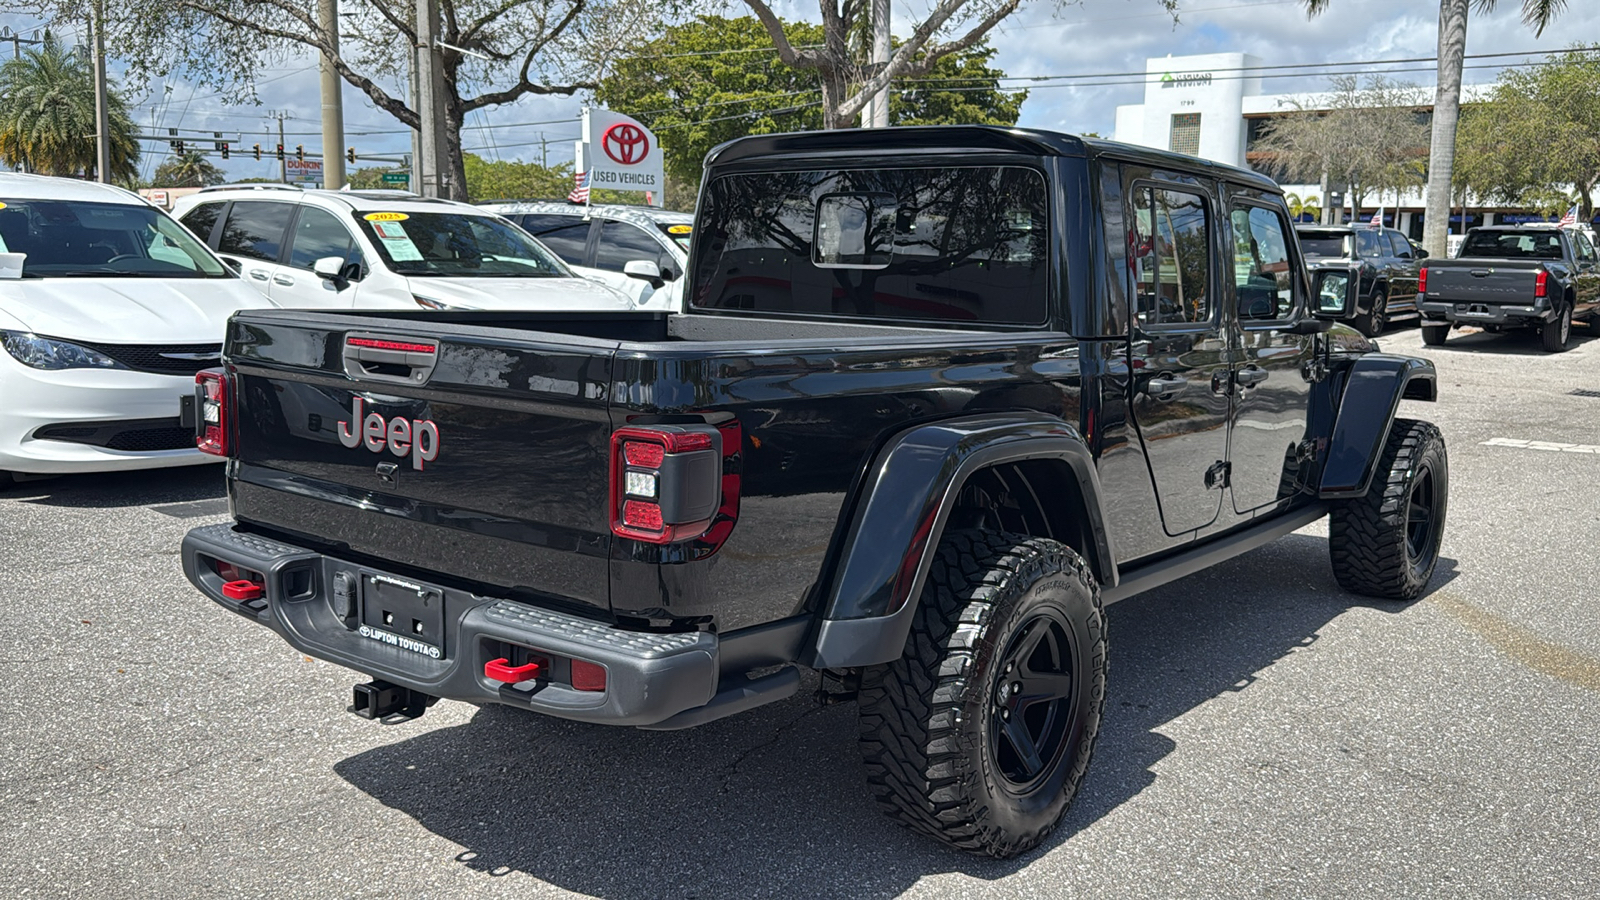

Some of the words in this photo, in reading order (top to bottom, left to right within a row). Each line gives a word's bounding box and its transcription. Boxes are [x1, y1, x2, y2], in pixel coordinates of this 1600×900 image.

[593, 171, 617, 183] USED
[618, 172, 655, 185] VEHICLES
[372, 213, 400, 221] 2025
[1442, 283, 1518, 293] TACOMA
[337, 396, 440, 471] Jeep
[370, 628, 398, 646] LIPTON
[398, 637, 430, 656] TOYOTA
